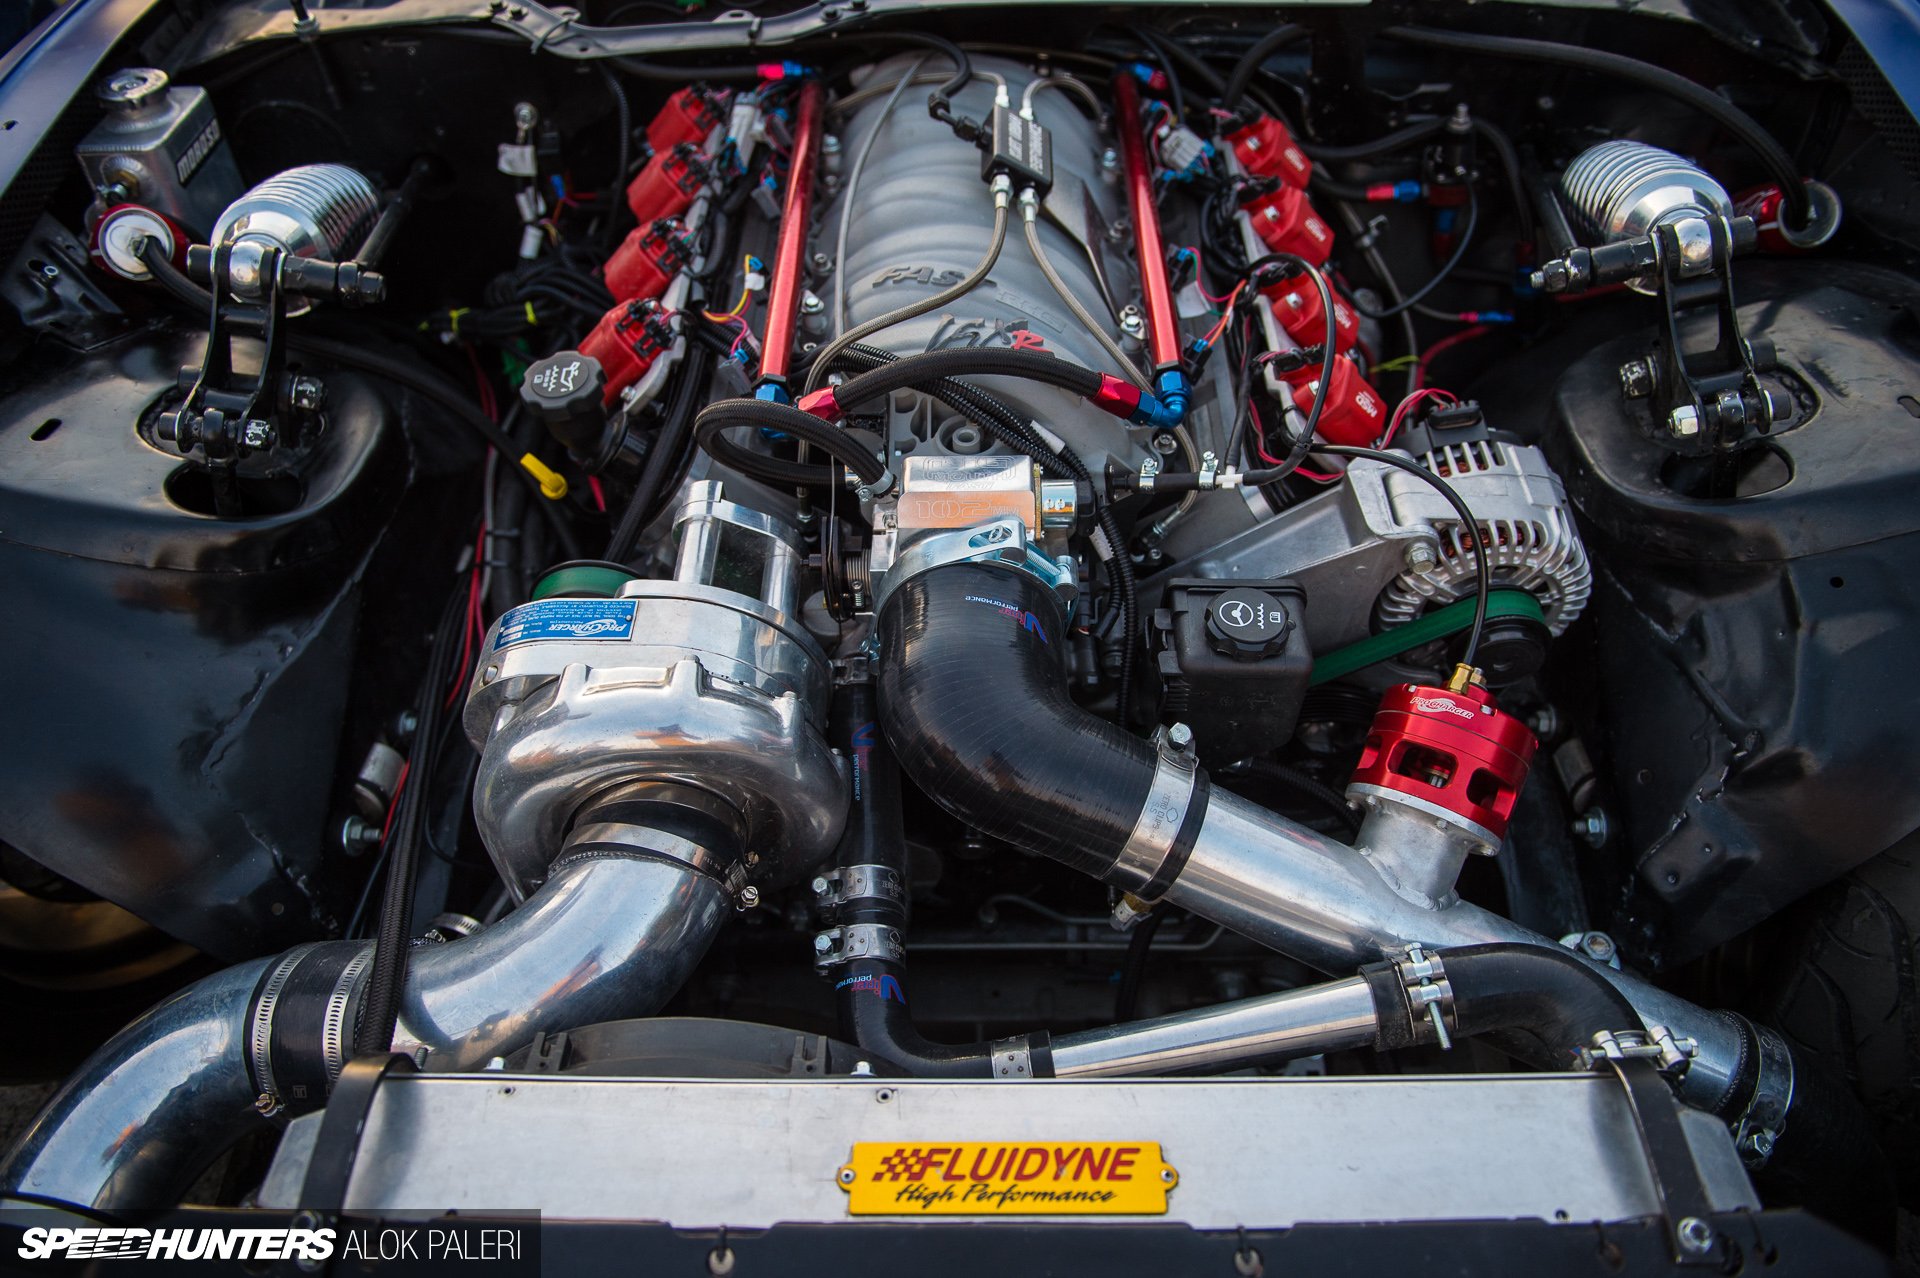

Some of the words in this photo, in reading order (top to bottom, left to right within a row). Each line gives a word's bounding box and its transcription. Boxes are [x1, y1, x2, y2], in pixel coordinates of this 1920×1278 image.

[177, 118, 221, 183] MOROSO
[873, 265, 997, 288] FAS
[1356, 394, 1378, 417] MSD
[964, 595, 1019, 612] performance
[549, 620, 628, 633] PROCHARGER
[1410, 697, 1475, 719] PROCHARGER
[853, 754, 861, 801] performance
[835, 973, 872, 991] performa
[914, 1148, 1141, 1181] FLUIDYNE
[896, 1183, 958, 1210] High
[962, 1183, 1118, 1210] Performance
